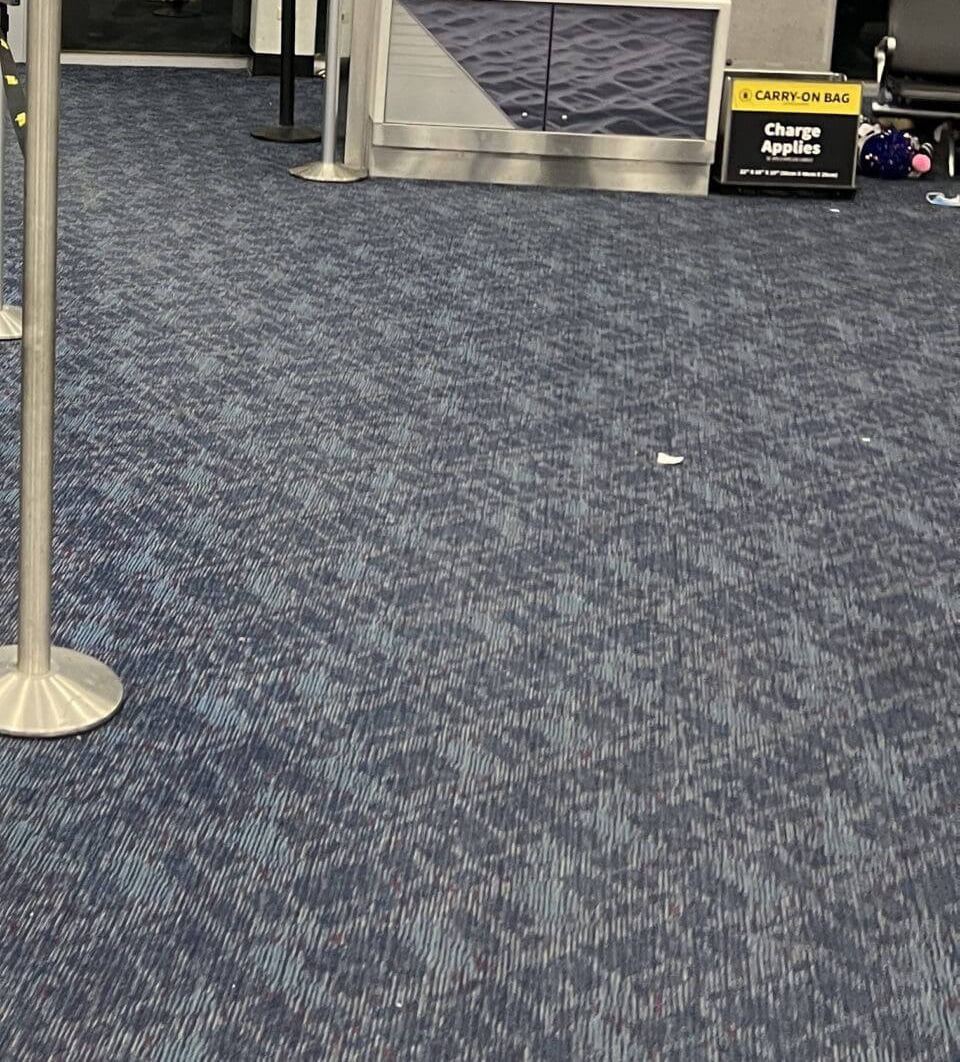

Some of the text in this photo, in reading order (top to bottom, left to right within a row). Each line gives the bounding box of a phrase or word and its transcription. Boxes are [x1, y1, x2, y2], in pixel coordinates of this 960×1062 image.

[755, 90, 850, 104] CARRY-ON BAG
[764, 122, 821, 140] Charge
[761, 139, 821, 156] Applies
